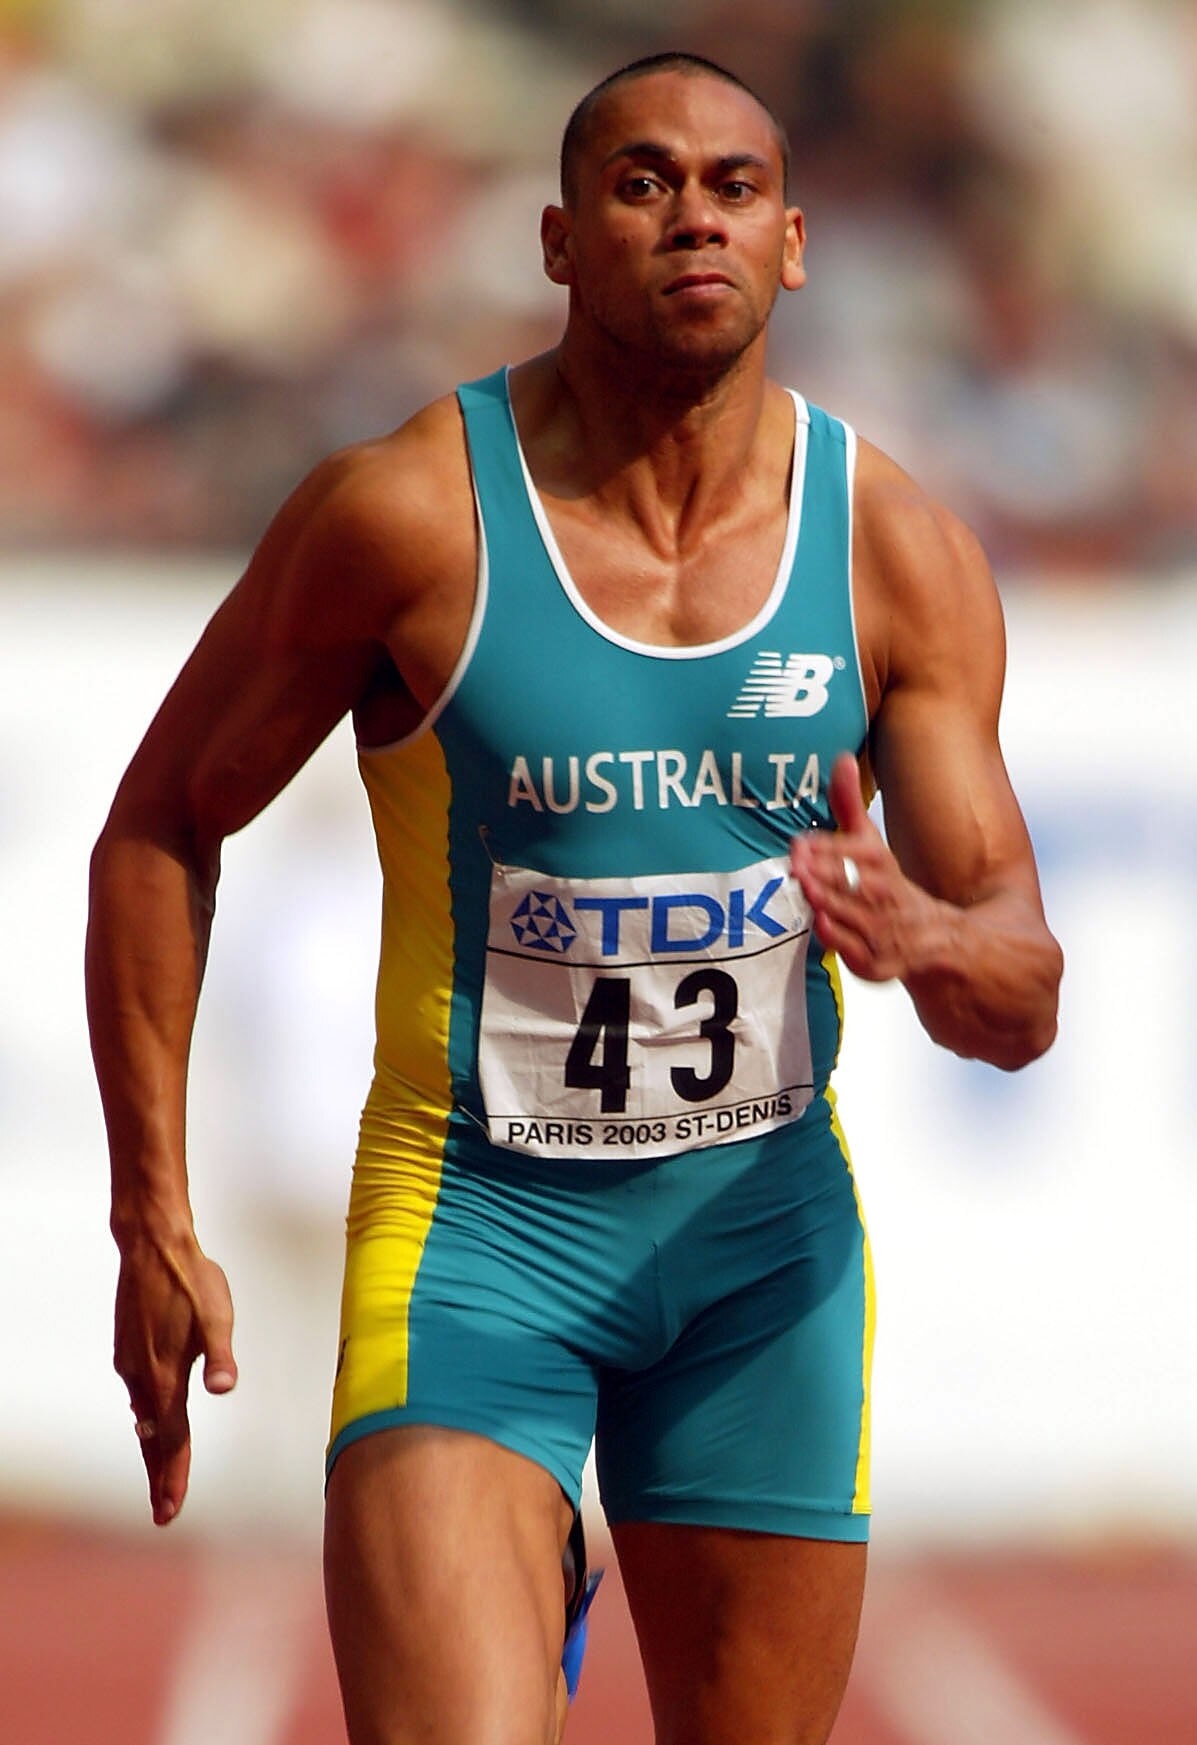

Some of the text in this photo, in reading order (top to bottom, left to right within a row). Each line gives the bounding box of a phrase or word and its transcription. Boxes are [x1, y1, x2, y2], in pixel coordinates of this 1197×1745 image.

[508, 749, 819, 814] AUSTRALIA
[574, 876, 788, 956] TDK
[507, 1094, 792, 1145] PARIS 2003 ST-DENIS
